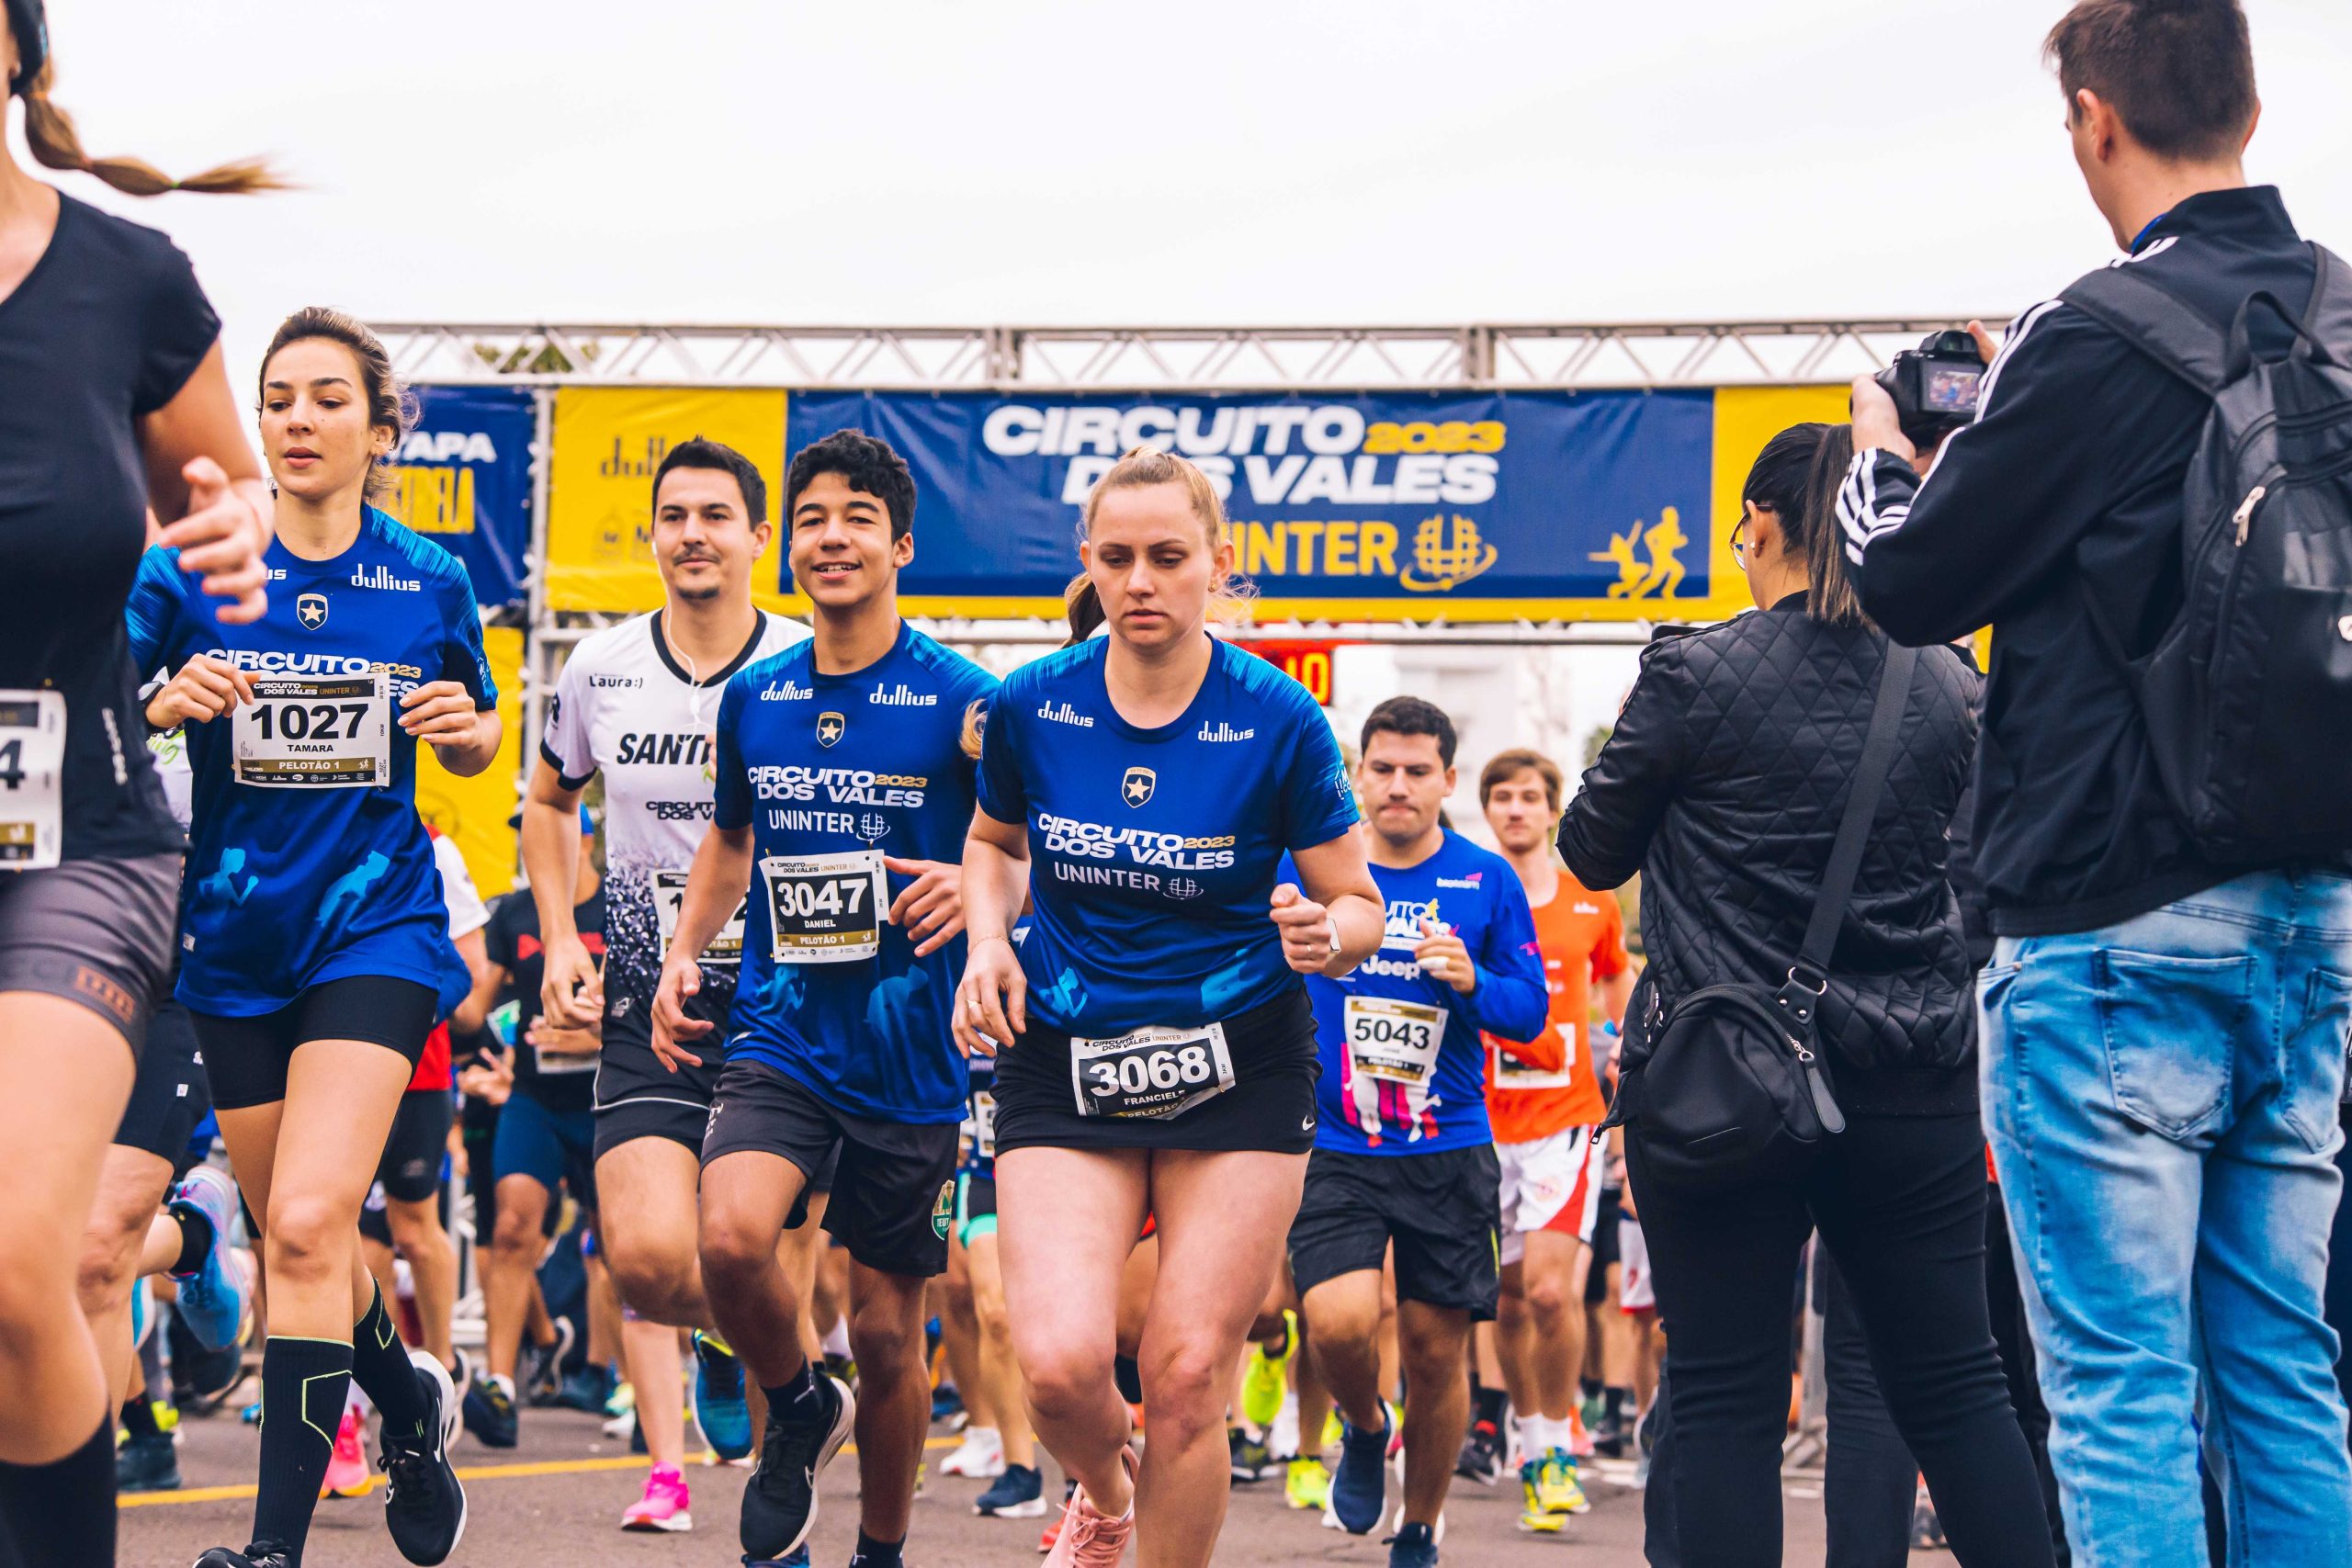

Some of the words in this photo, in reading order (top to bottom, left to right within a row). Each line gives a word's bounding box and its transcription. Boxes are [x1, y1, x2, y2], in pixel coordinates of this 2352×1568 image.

[982, 405, 1365, 456] CIRCUITO
[1363, 420, 1507, 454] 2023
[1061, 455, 1235, 504] DS
[1243, 454, 1498, 504] VALES
[1221, 521, 1398, 576] INTER
[351, 563, 421, 592] dullius
[205, 649, 371, 675] CIRCUITO
[369, 661, 422, 678] 2023
[320, 687, 350, 695] UNINTER
[761, 681, 814, 701] dullius
[869, 683, 937, 705] dullius
[251, 704, 369, 740] 1027
[1037, 700, 1094, 728] dullius
[1198, 721, 1254, 742] dullius
[278, 761, 331, 770] PELOTÃO
[334, 761, 340, 770] 1
[748, 766, 876, 788] CIRCUITO
[875, 774, 928, 787] 2023
[646, 801, 715, 811] CIRCUIT
[757, 784, 815, 801] DOS
[828, 785, 925, 808] VALES
[658, 811, 695, 820] DOS
[768, 809, 854, 834] UNINTER
[1038, 813, 1184, 852] CIRCUITO
[1183, 835, 1236, 850] 2023
[1045, 834, 1115, 859] DOS
[1130, 845, 1235, 871] VALES
[1054, 862, 1160, 892] UNINTER
[777, 877, 868, 918] 3047
[804, 919, 837, 929] DANIEL
[799, 936, 837, 945] PELOTÃO
[1362, 954, 1421, 980] Jeep
[1102, 1043, 1122, 1052] DOS
[1124, 1036, 1151, 1048] VALES
[1355, 1018, 1430, 1050] 5043
[1089, 1046, 1210, 1097] 3068
